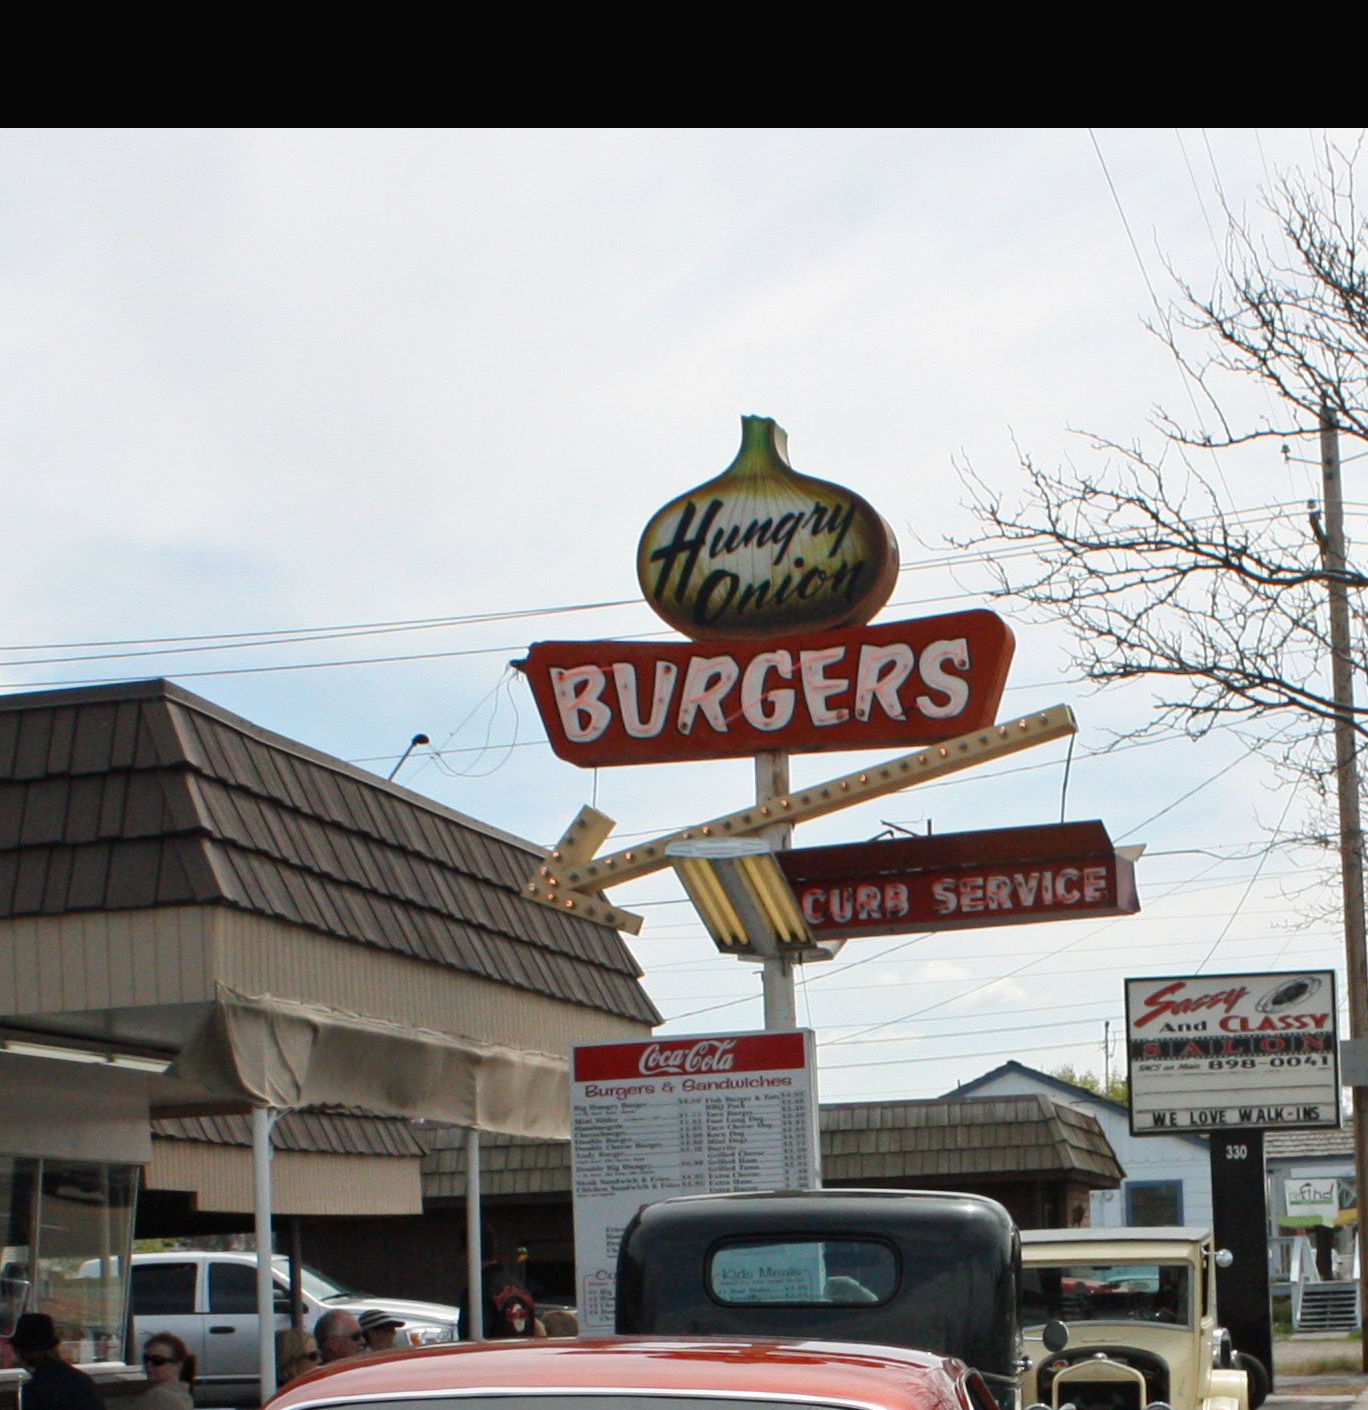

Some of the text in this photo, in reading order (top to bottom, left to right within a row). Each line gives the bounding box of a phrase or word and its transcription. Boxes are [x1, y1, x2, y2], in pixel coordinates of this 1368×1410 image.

[650, 499, 856, 601] Hungry
[695, 556, 867, 624] Onion
[549, 638, 970, 743] BURGERS
[802, 866, 1107, 926] CURB SERVICE
[1133, 981, 1251, 1028] Sassy
[1159, 1013, 1329, 1033] And CLASSY
[638, 1038, 738, 1076] Coca-Cola
[1143, 1036, 1325, 1057] SALON
[1208, 1055, 1329, 1070] 898-0041
[585, 1076, 793, 1100] Burgers & Sandwiches
[1152, 1106, 1320, 1127] WE LOVE WALK-INS
[1225, 1145, 1248, 1160] 330
